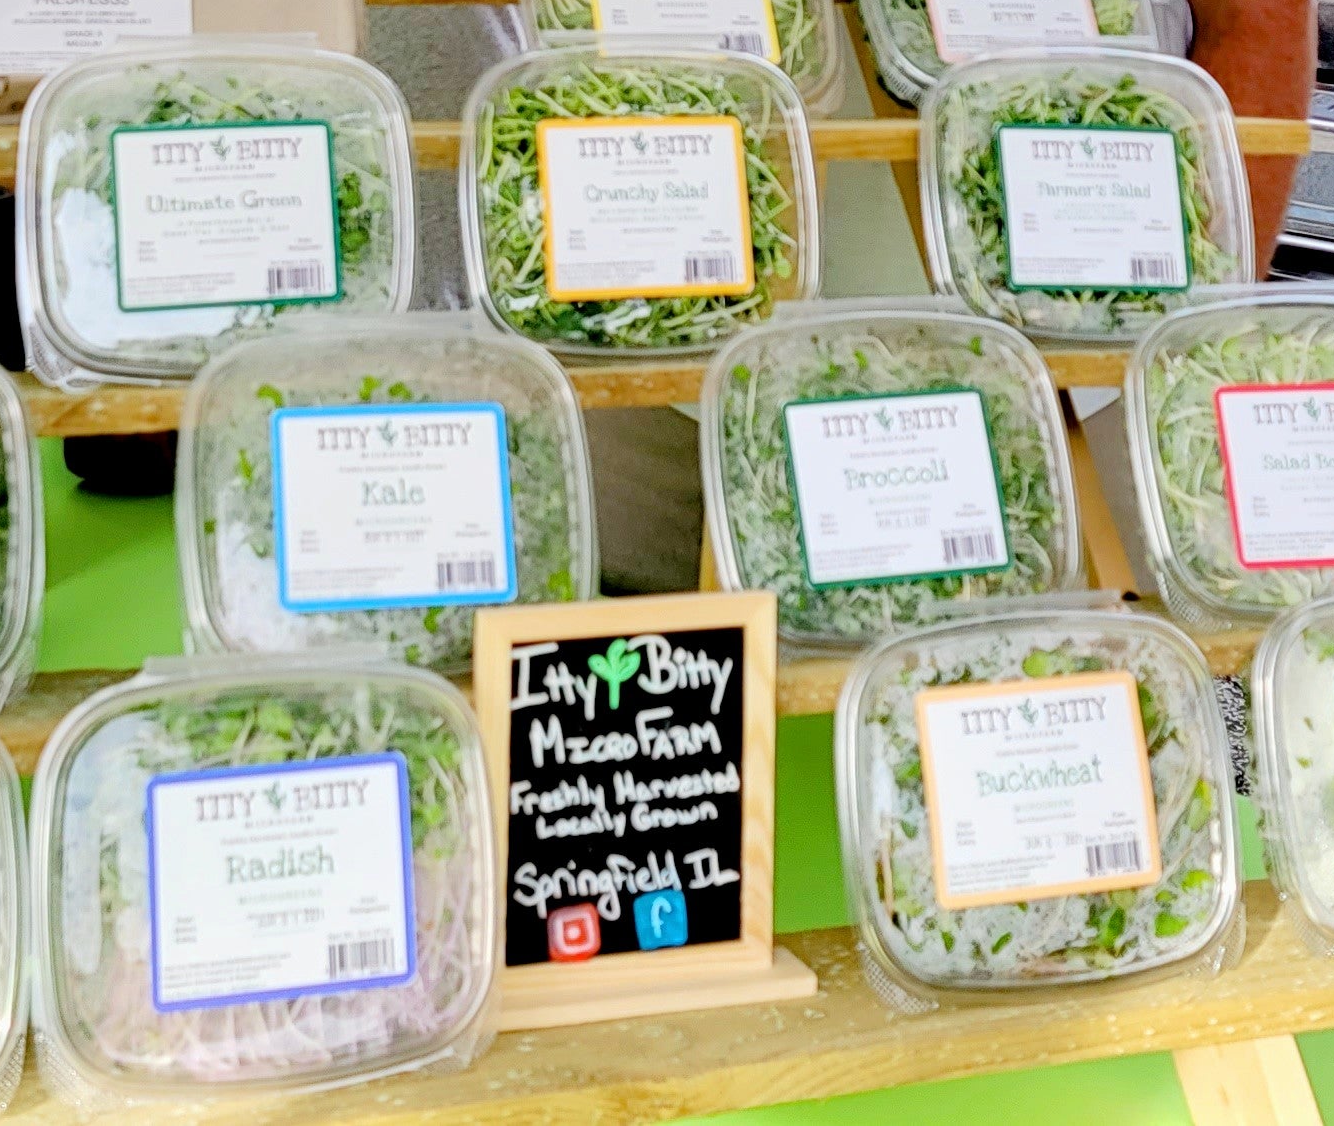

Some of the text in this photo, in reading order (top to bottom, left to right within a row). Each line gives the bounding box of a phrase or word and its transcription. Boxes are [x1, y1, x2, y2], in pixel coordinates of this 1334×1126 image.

[585, 183, 659, 204] Crunchy
[843, 458, 948, 491] Broccoli
[1263, 453, 1311, 470] Salad
[361, 477, 426, 507] Kale
[510, 634, 733, 721] Itty Bitty
[510, 761, 741, 815] Freshly Harvested
[975, 753, 1103, 798] Buckwheat
[631, 800, 718, 832] Grown
[225, 845, 335, 885] Radish
